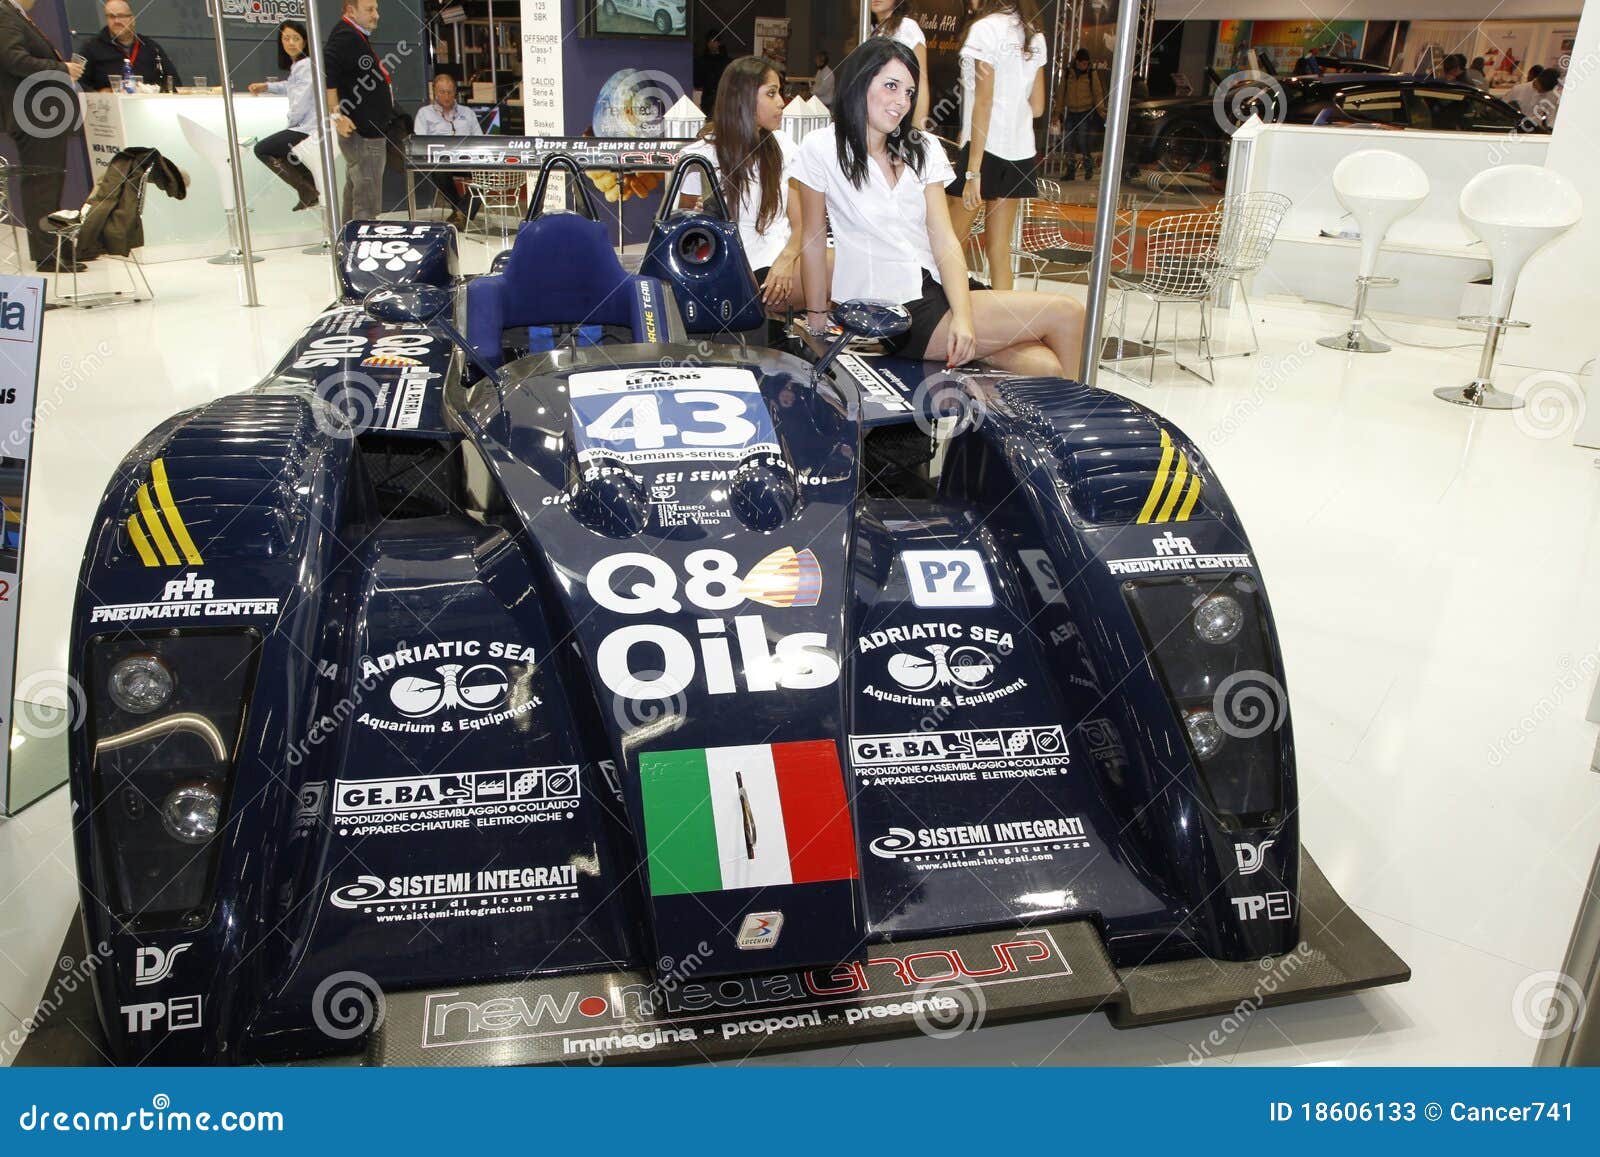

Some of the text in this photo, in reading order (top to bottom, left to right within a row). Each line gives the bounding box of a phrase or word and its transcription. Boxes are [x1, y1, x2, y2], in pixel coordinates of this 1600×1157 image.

[524, 34, 558, 44] OFFSHORE
[531, 77, 555, 86] CALCIO
[508, 140, 531, 150] CIAO
[573, 141, 588, 150] SEI
[598, 141, 635, 151] SEMPRE
[639, 141, 657, 151] CON
[625, 373, 702, 386] LE MANS
[627, 381, 675, 391] SERIES
[586, 391, 757, 450] 43
[588, 443, 771, 463] www.lemans-series.com
[655, 472, 684, 485] SEI
[798, 475, 829, 486] NOI
[667, 510, 731, 519] Provincial
[668, 517, 721, 527] del Vino
[1108, 556, 1253, 575] PNEUMATIC CENTER
[586, 549, 745, 615] Q8
[919, 560, 976, 593] P2
[90, 602, 279, 623] PNEUMATIC CENTER
[858, 623, 1014, 653] ADRIATIC SEA
[362, 640, 481, 679] ADRIATIC
[488, 641, 536, 664] SEA
[596, 614, 840, 700] Oils
[862, 677, 1028, 708] Aquarium & Equipment
[357, 695, 543, 733] Aquarium & Equipment
[857, 740, 941, 760] GE.BA
[855, 756, 1070, 776] PRODUZIONE ASSEMBLAGGIO COLLAUDO
[874, 767, 1057, 786] APPARECCHIATURE ELETTRONICHE
[342, 784, 437, 807] GE.BA
[335, 799, 580, 825] PRODUZIONE ASSEMBLAGGIO COLLAUDO
[352, 812, 562, 837] APPARECCHIATURE ELETTRONICHE
[919, 817, 1085, 847] SISTEMI INTEGRATI
[903, 841, 1091, 863] servizi di sicurezza
[916, 851, 1053, 871] www.sistemi-integrati.com
[388, 864, 578, 898] SISTEMI INTEGRATI
[364, 891, 579, 914] servizi di sicurezza
[376, 903, 533, 924] www.sistemi-integrati.com
[722, 1009, 821, 1040] proponi
[846, 994, 959, 1025] presenta
